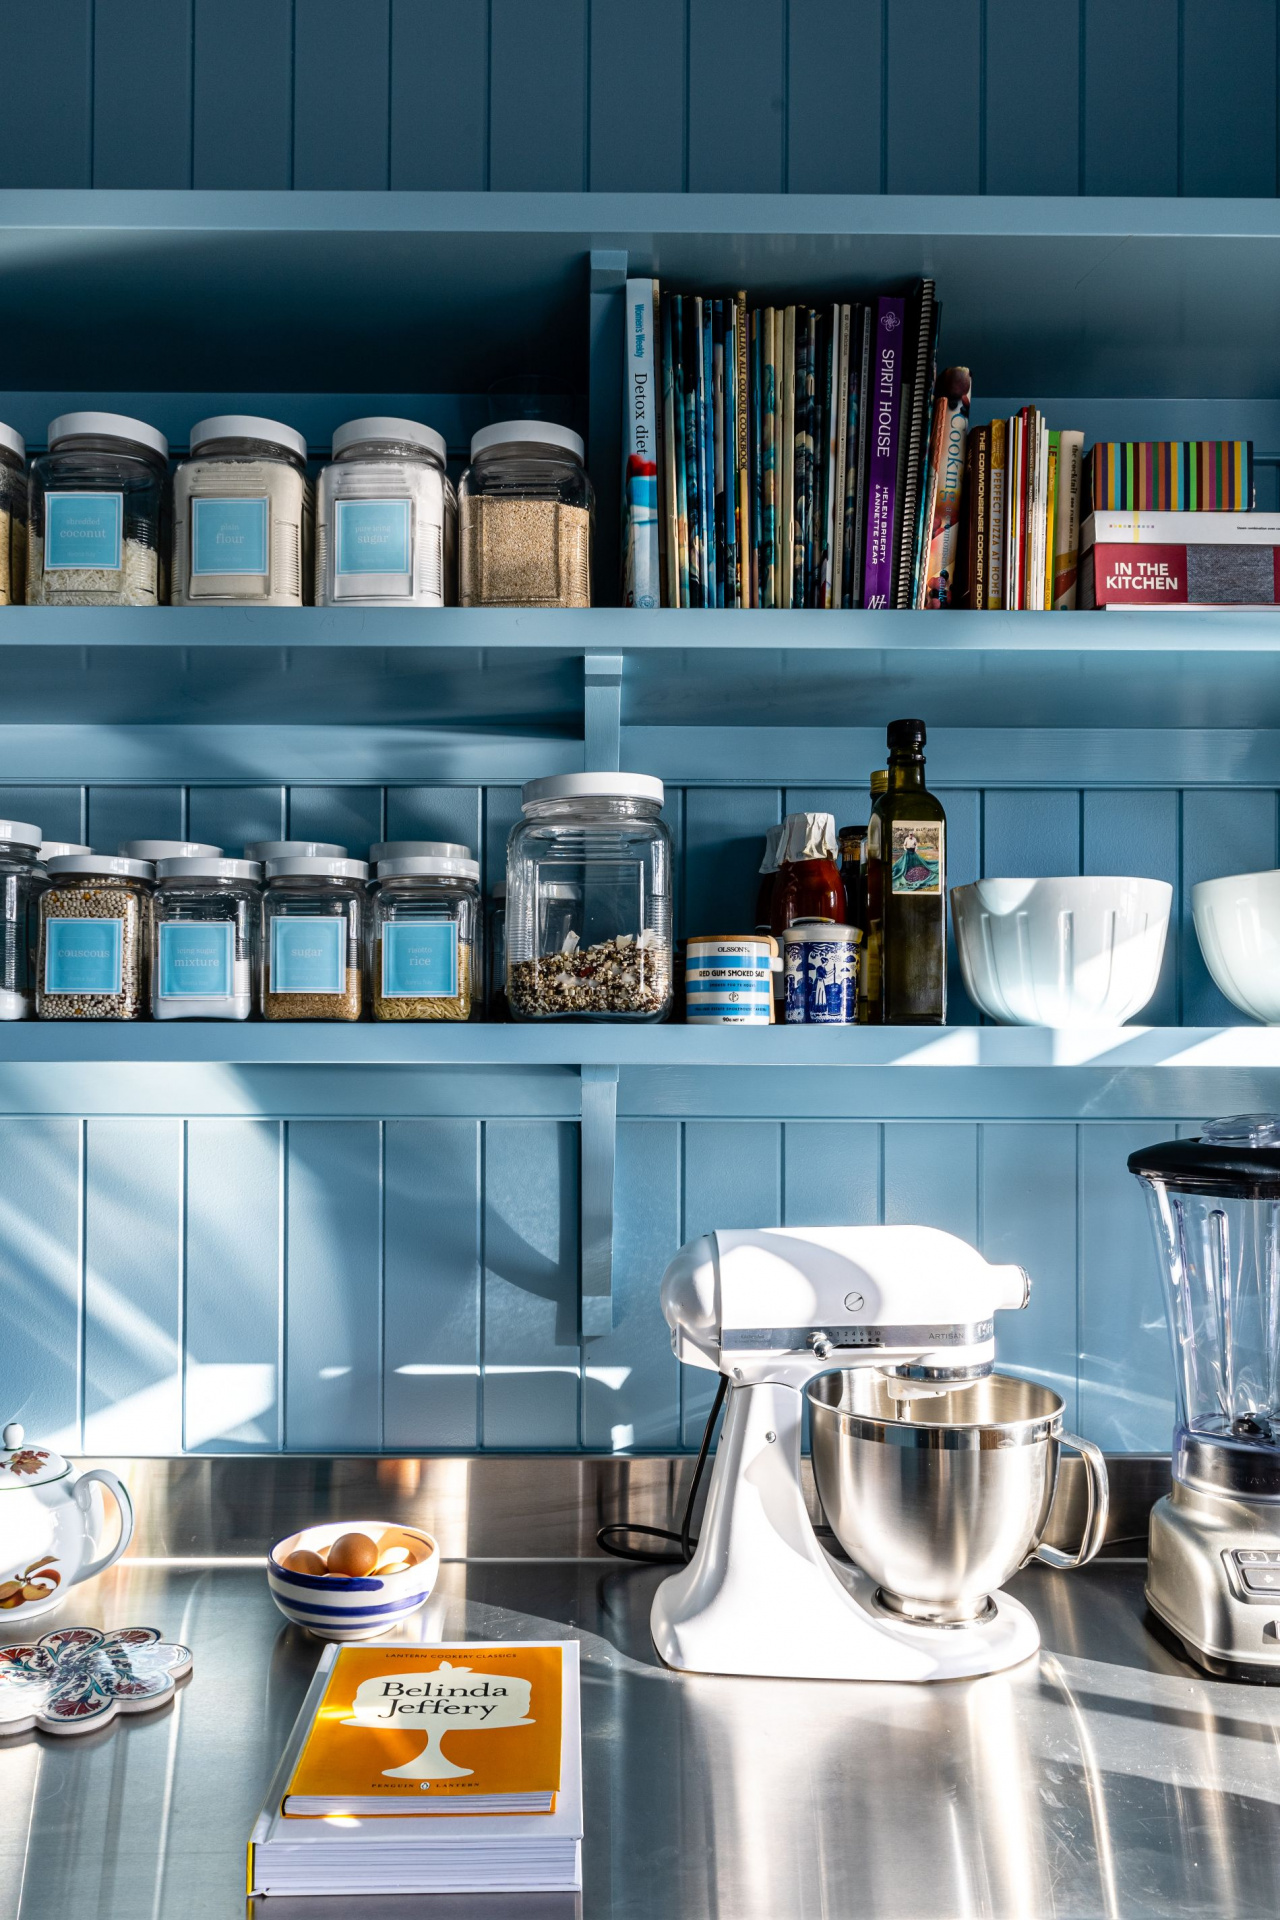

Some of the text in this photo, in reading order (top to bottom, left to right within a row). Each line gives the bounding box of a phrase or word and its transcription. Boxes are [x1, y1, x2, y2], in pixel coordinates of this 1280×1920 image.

[634, 303, 645, 358] Women's Weekly
[738, 298, 748, 470] AUSTRALIAN ALL COLOUR COOKBOOK
[877, 349, 895, 457] SPIRIT HOUSE
[634, 373, 649, 455] Detox diet
[940, 412, 966, 503] Cooking
[1071, 444, 1079, 458] the
[1070, 459, 1078, 494] cocktail
[977, 452, 985, 533] COMMONSENSE
[66, 517, 100, 526] shredded
[872, 492, 880, 539] ANNETTE
[60, 528, 106, 538] coconut
[220, 524, 240, 532] plain
[992, 472, 1001, 595] PERFECT PIZZA AT HOME
[216, 533, 245, 544] flour
[357, 534, 389, 545] sugar
[879, 521, 888, 564] BRIERTY
[871, 540, 879, 565] FEAR
[976, 534, 984, 582] COOKERY
[1114, 562, 1169, 576] IN THE
[1106, 576, 1178, 590] KITCHEN
[58, 949, 110, 958] couscous
[291, 948, 323, 958] sugar
[409, 955, 432, 966] rice
[174, 957, 220, 967] mixture
[755, 970, 765, 978] SALT
[378, 1681, 509, 1698] Belinda
[377, 1698, 499, 1721] Jeffery
